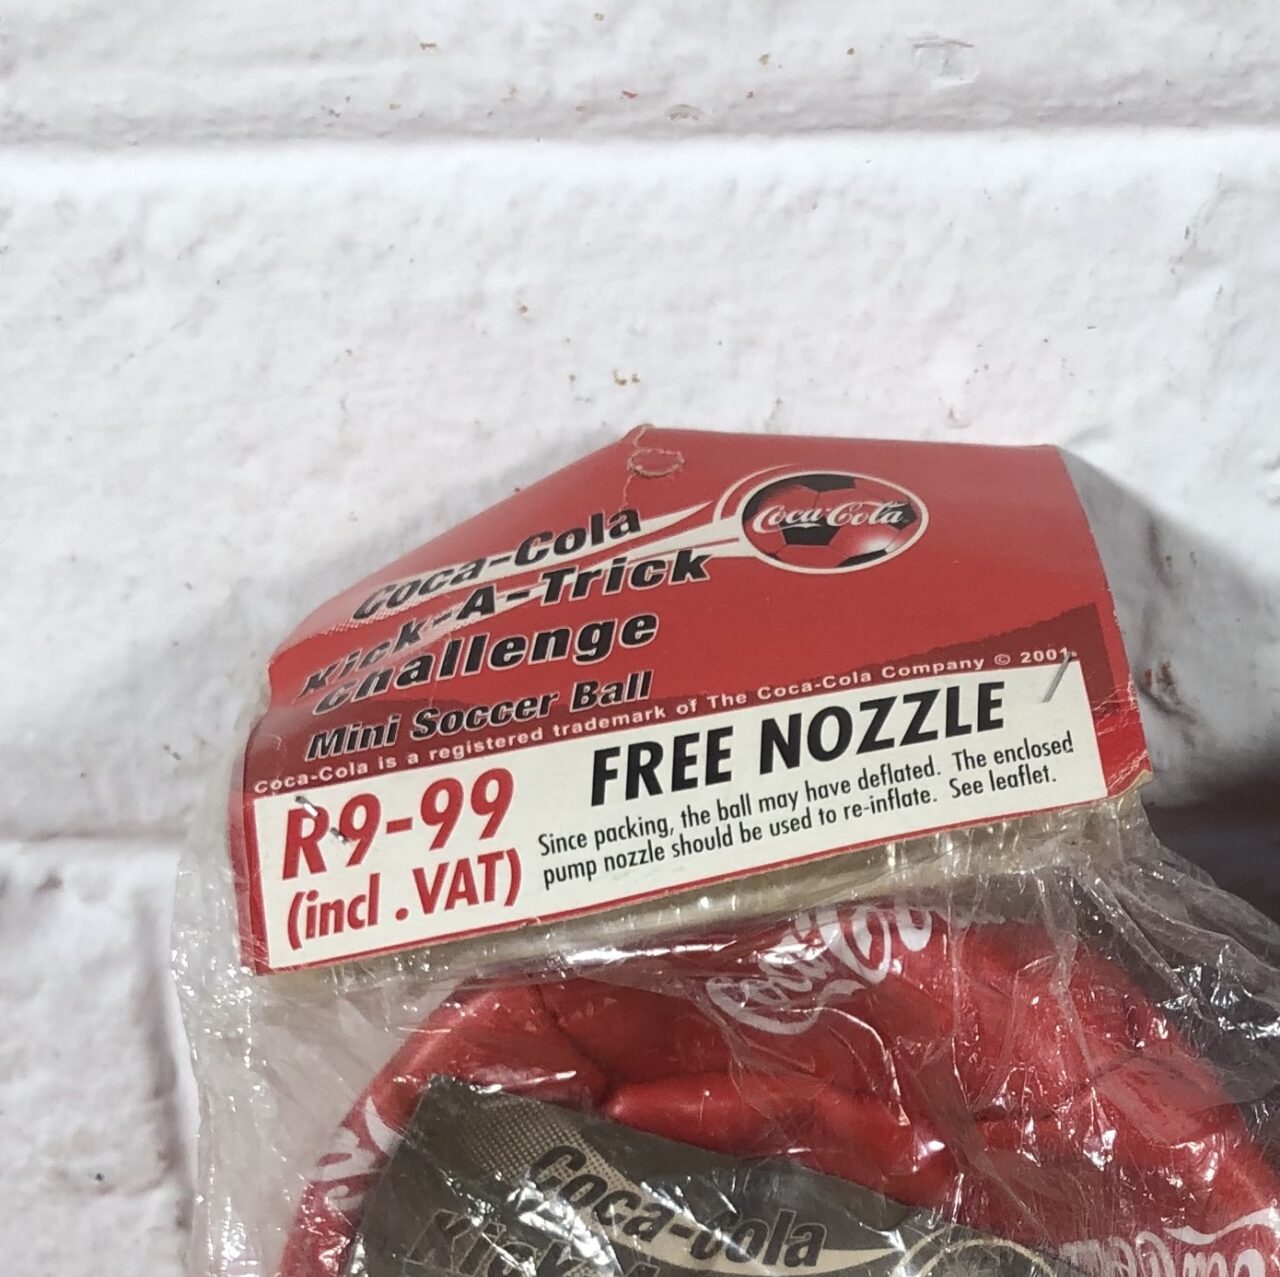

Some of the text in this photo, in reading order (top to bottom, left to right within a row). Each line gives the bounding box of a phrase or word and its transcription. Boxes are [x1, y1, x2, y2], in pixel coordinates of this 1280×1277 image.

[300, 548, 712, 700] Kick-A-Trick
[351, 507, 644, 623] Coca-Cola
[254, 760, 369, 795] Coca-Cola
[377, 755, 397, 769] is
[407, 752, 419, 764] a
[429, 727, 545, 761] registered
[552, 706, 667, 744] trademark
[676, 698, 699, 715] of
[707, 690, 748, 708] The
[757, 669, 872, 700] Coca-Cola
[881, 655, 985, 680] Company
[304, 671, 652, 762] Mini Soccer Ball
[312, 612, 660, 716] Challenge
[537, 730, 1075, 856] Since packing, the ball may have deflated. The enclosed
[590, 681, 1006, 807] FREE NOZZLE
[282, 767, 515, 880] R9-99
[543, 763, 1058, 890] pump nozzle should be used to re-inflate. See leaflet.
